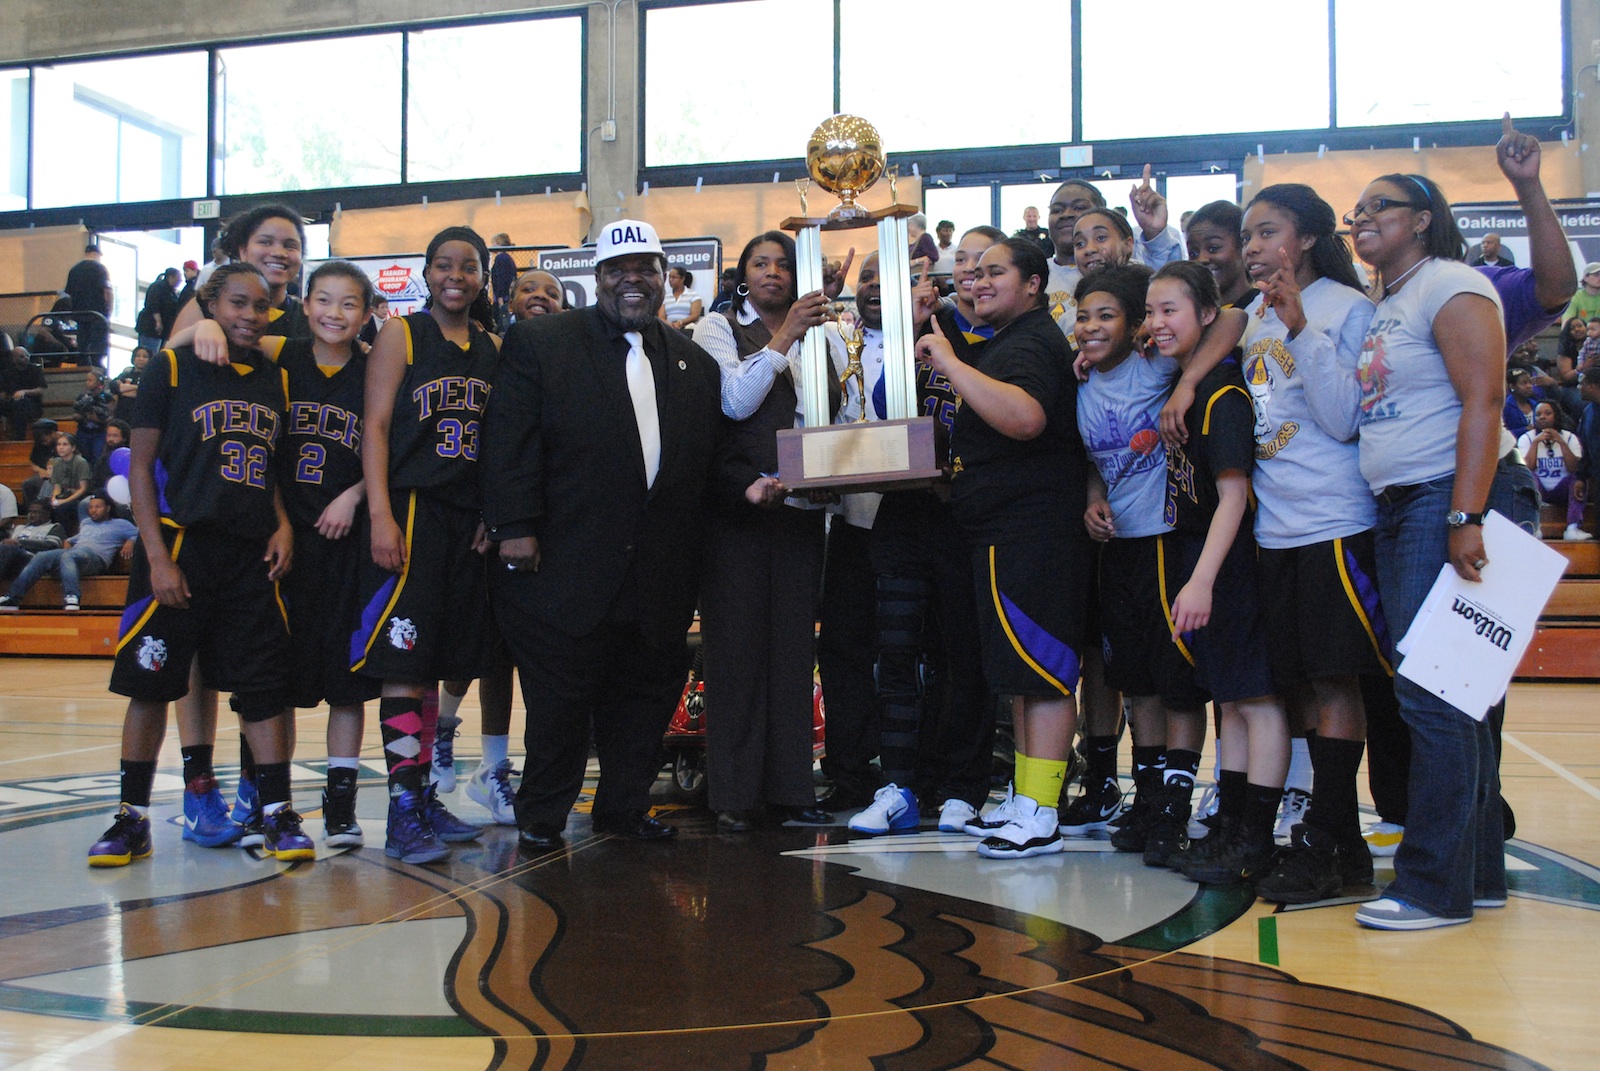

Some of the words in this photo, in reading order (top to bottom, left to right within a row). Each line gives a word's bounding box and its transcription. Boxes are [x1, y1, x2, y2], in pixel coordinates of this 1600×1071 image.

[197, 202, 213, 216] EXIT
[1457, 215, 1528, 229] Oakland
[1557, 214, 1600, 227] letic
[611, 226, 648, 246] OAL
[542, 256, 597, 270] Oakland
[667, 252, 711, 266] eague
[413, 376, 492, 421] TEC
[288, 401, 364, 457] ECH
[436, 418, 480, 462] 33
[220, 439, 267, 490] 32
[295, 441, 327, 485] 2
[1538, 456, 1564, 469] NIGHT
[1450, 597, 1513, 652] Wilson
